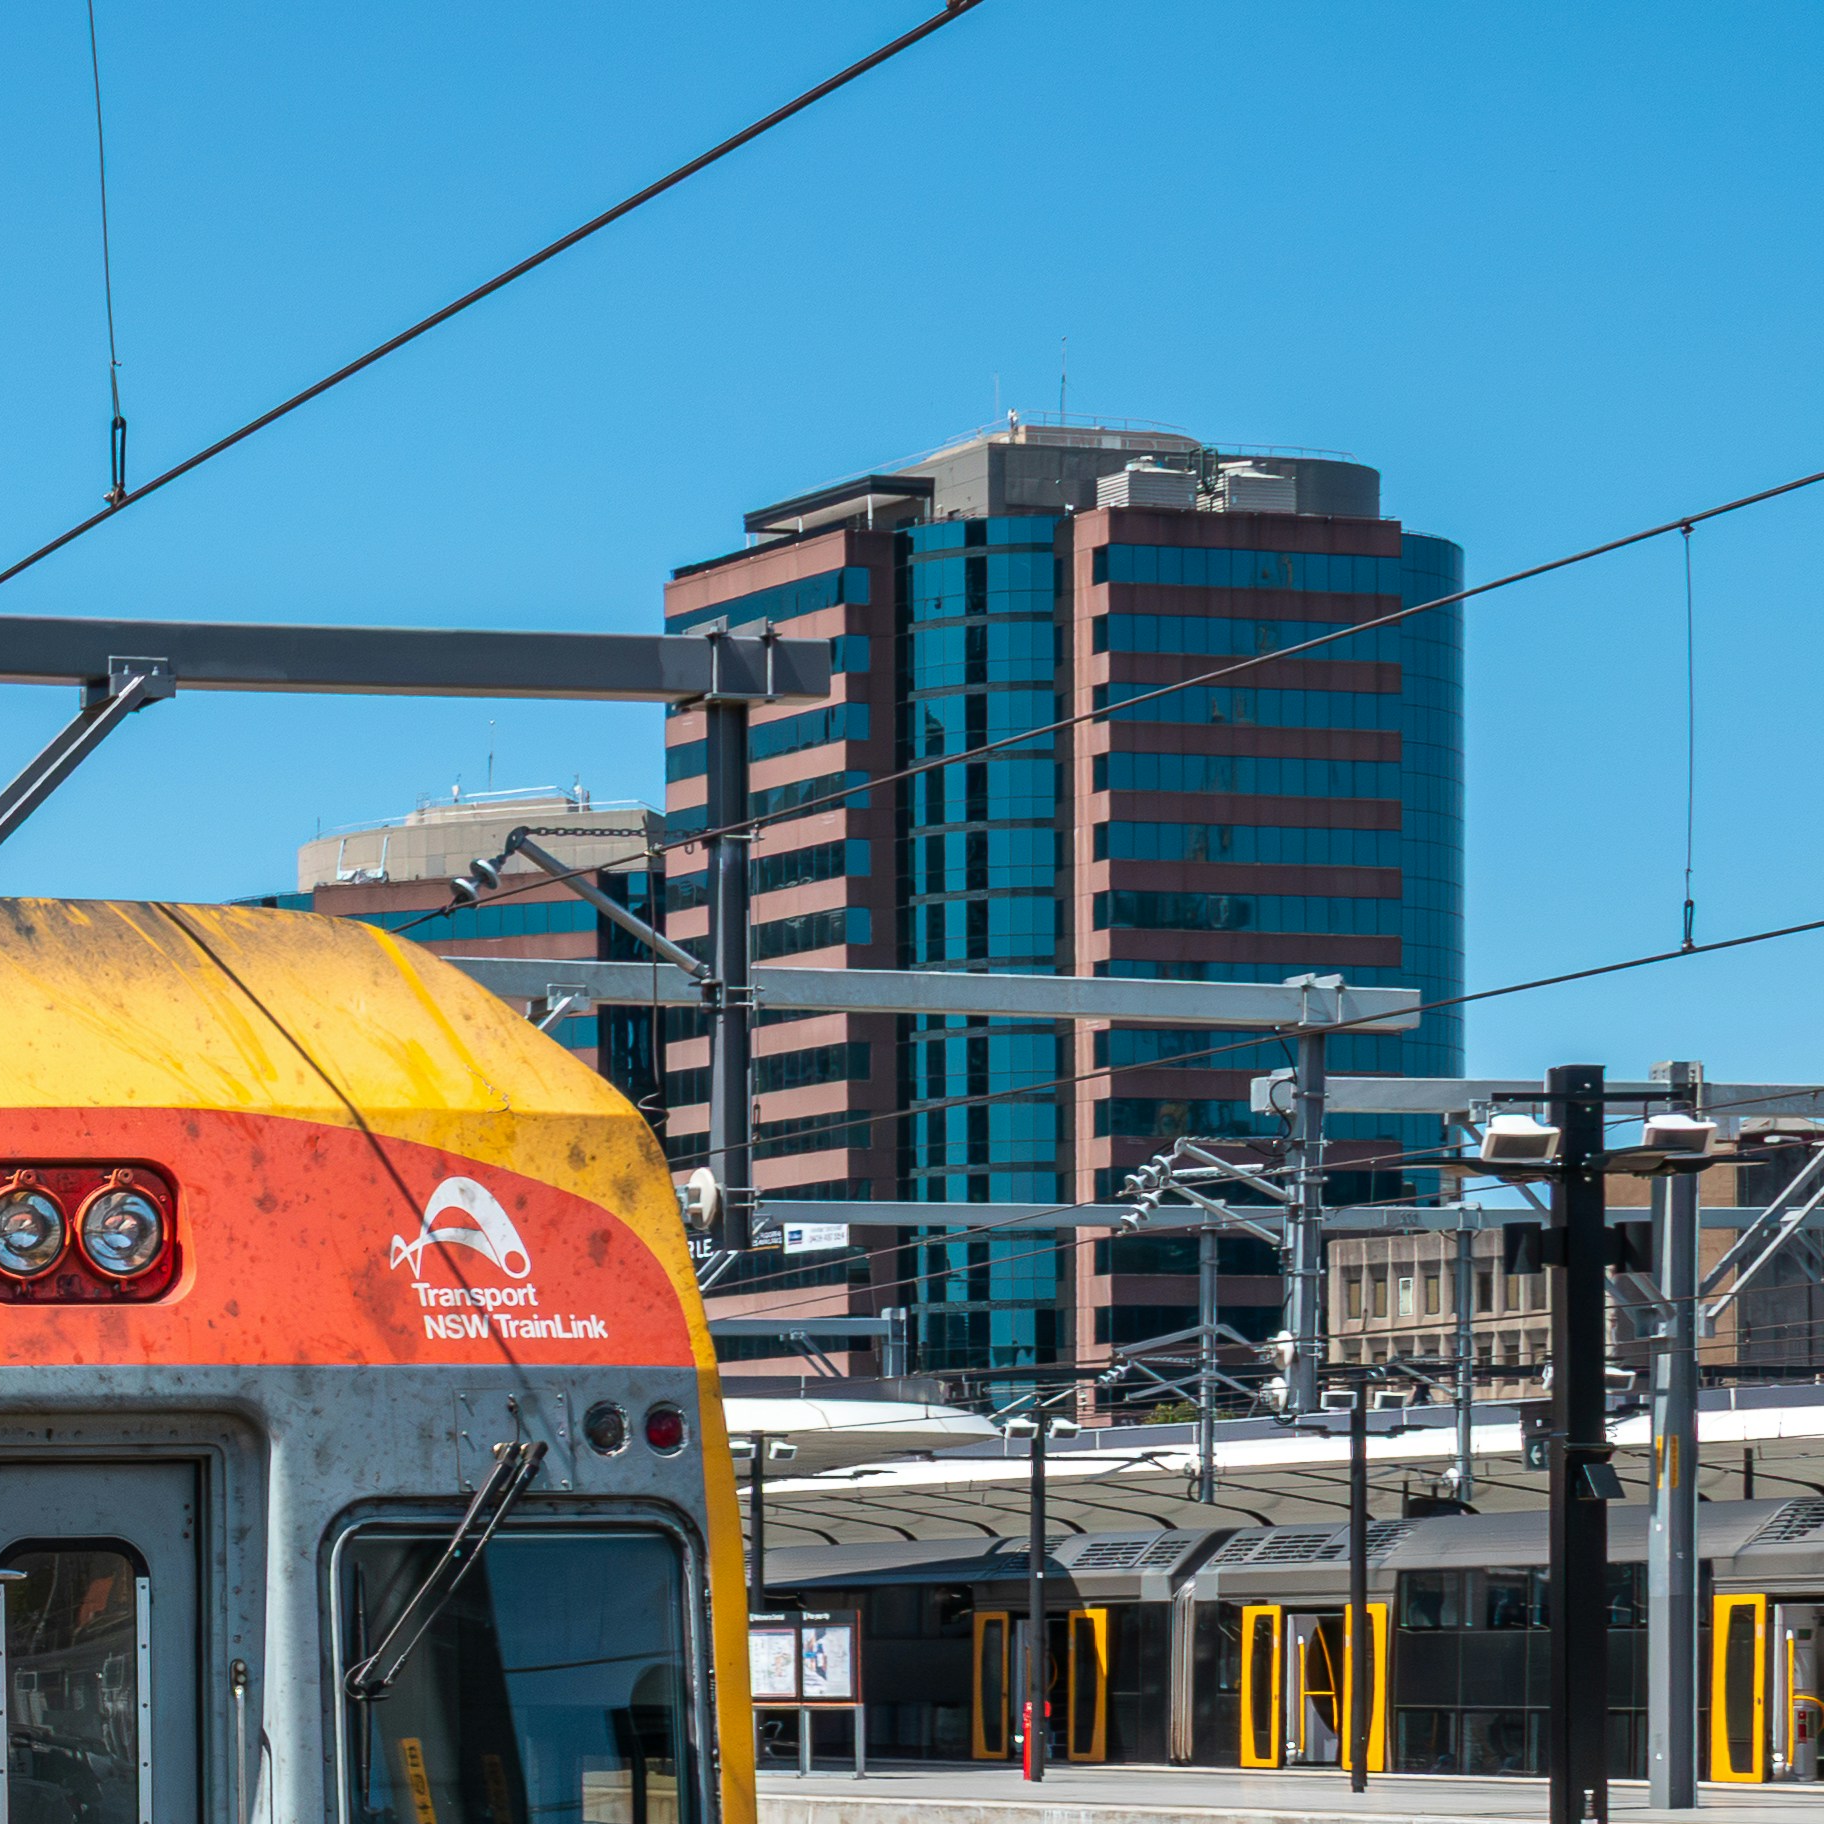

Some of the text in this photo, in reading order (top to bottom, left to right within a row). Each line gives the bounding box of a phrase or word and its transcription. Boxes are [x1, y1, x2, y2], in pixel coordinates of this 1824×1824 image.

[411, 1282, 539, 1311] Transport
[424, 1314, 608, 1339] NSW TrainLink
